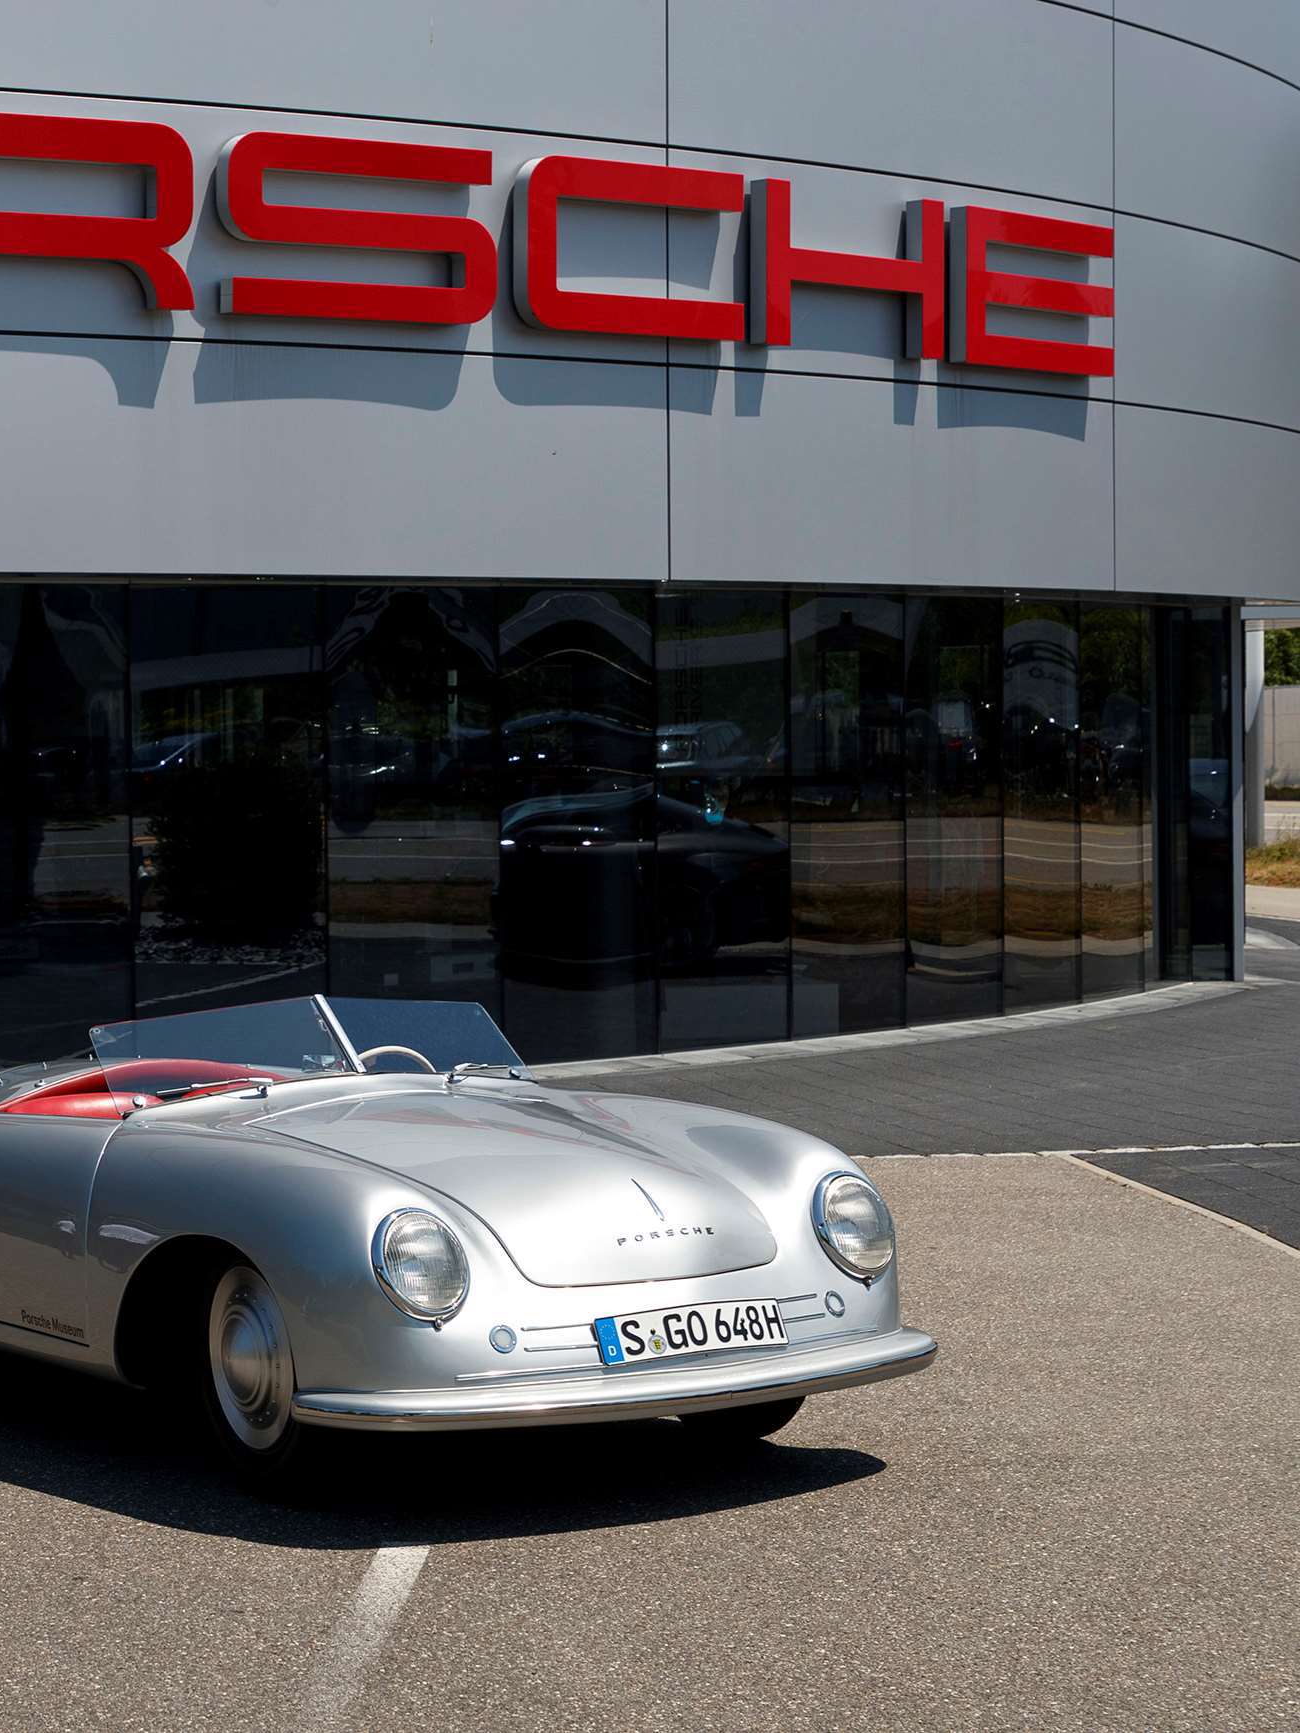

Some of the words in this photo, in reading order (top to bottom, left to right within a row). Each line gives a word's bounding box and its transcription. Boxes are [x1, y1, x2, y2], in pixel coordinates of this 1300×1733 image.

[616, 1226, 715, 1246] PORSCHE
[21, 1309, 51, 1329] Porsche
[52, 1316, 84, 1338] Museum
[620, 1320, 646, 1356] S
[663, 1310, 708, 1350] GO
[715, 1304, 784, 1343] 648H
[609, 1345, 617, 1356] D
